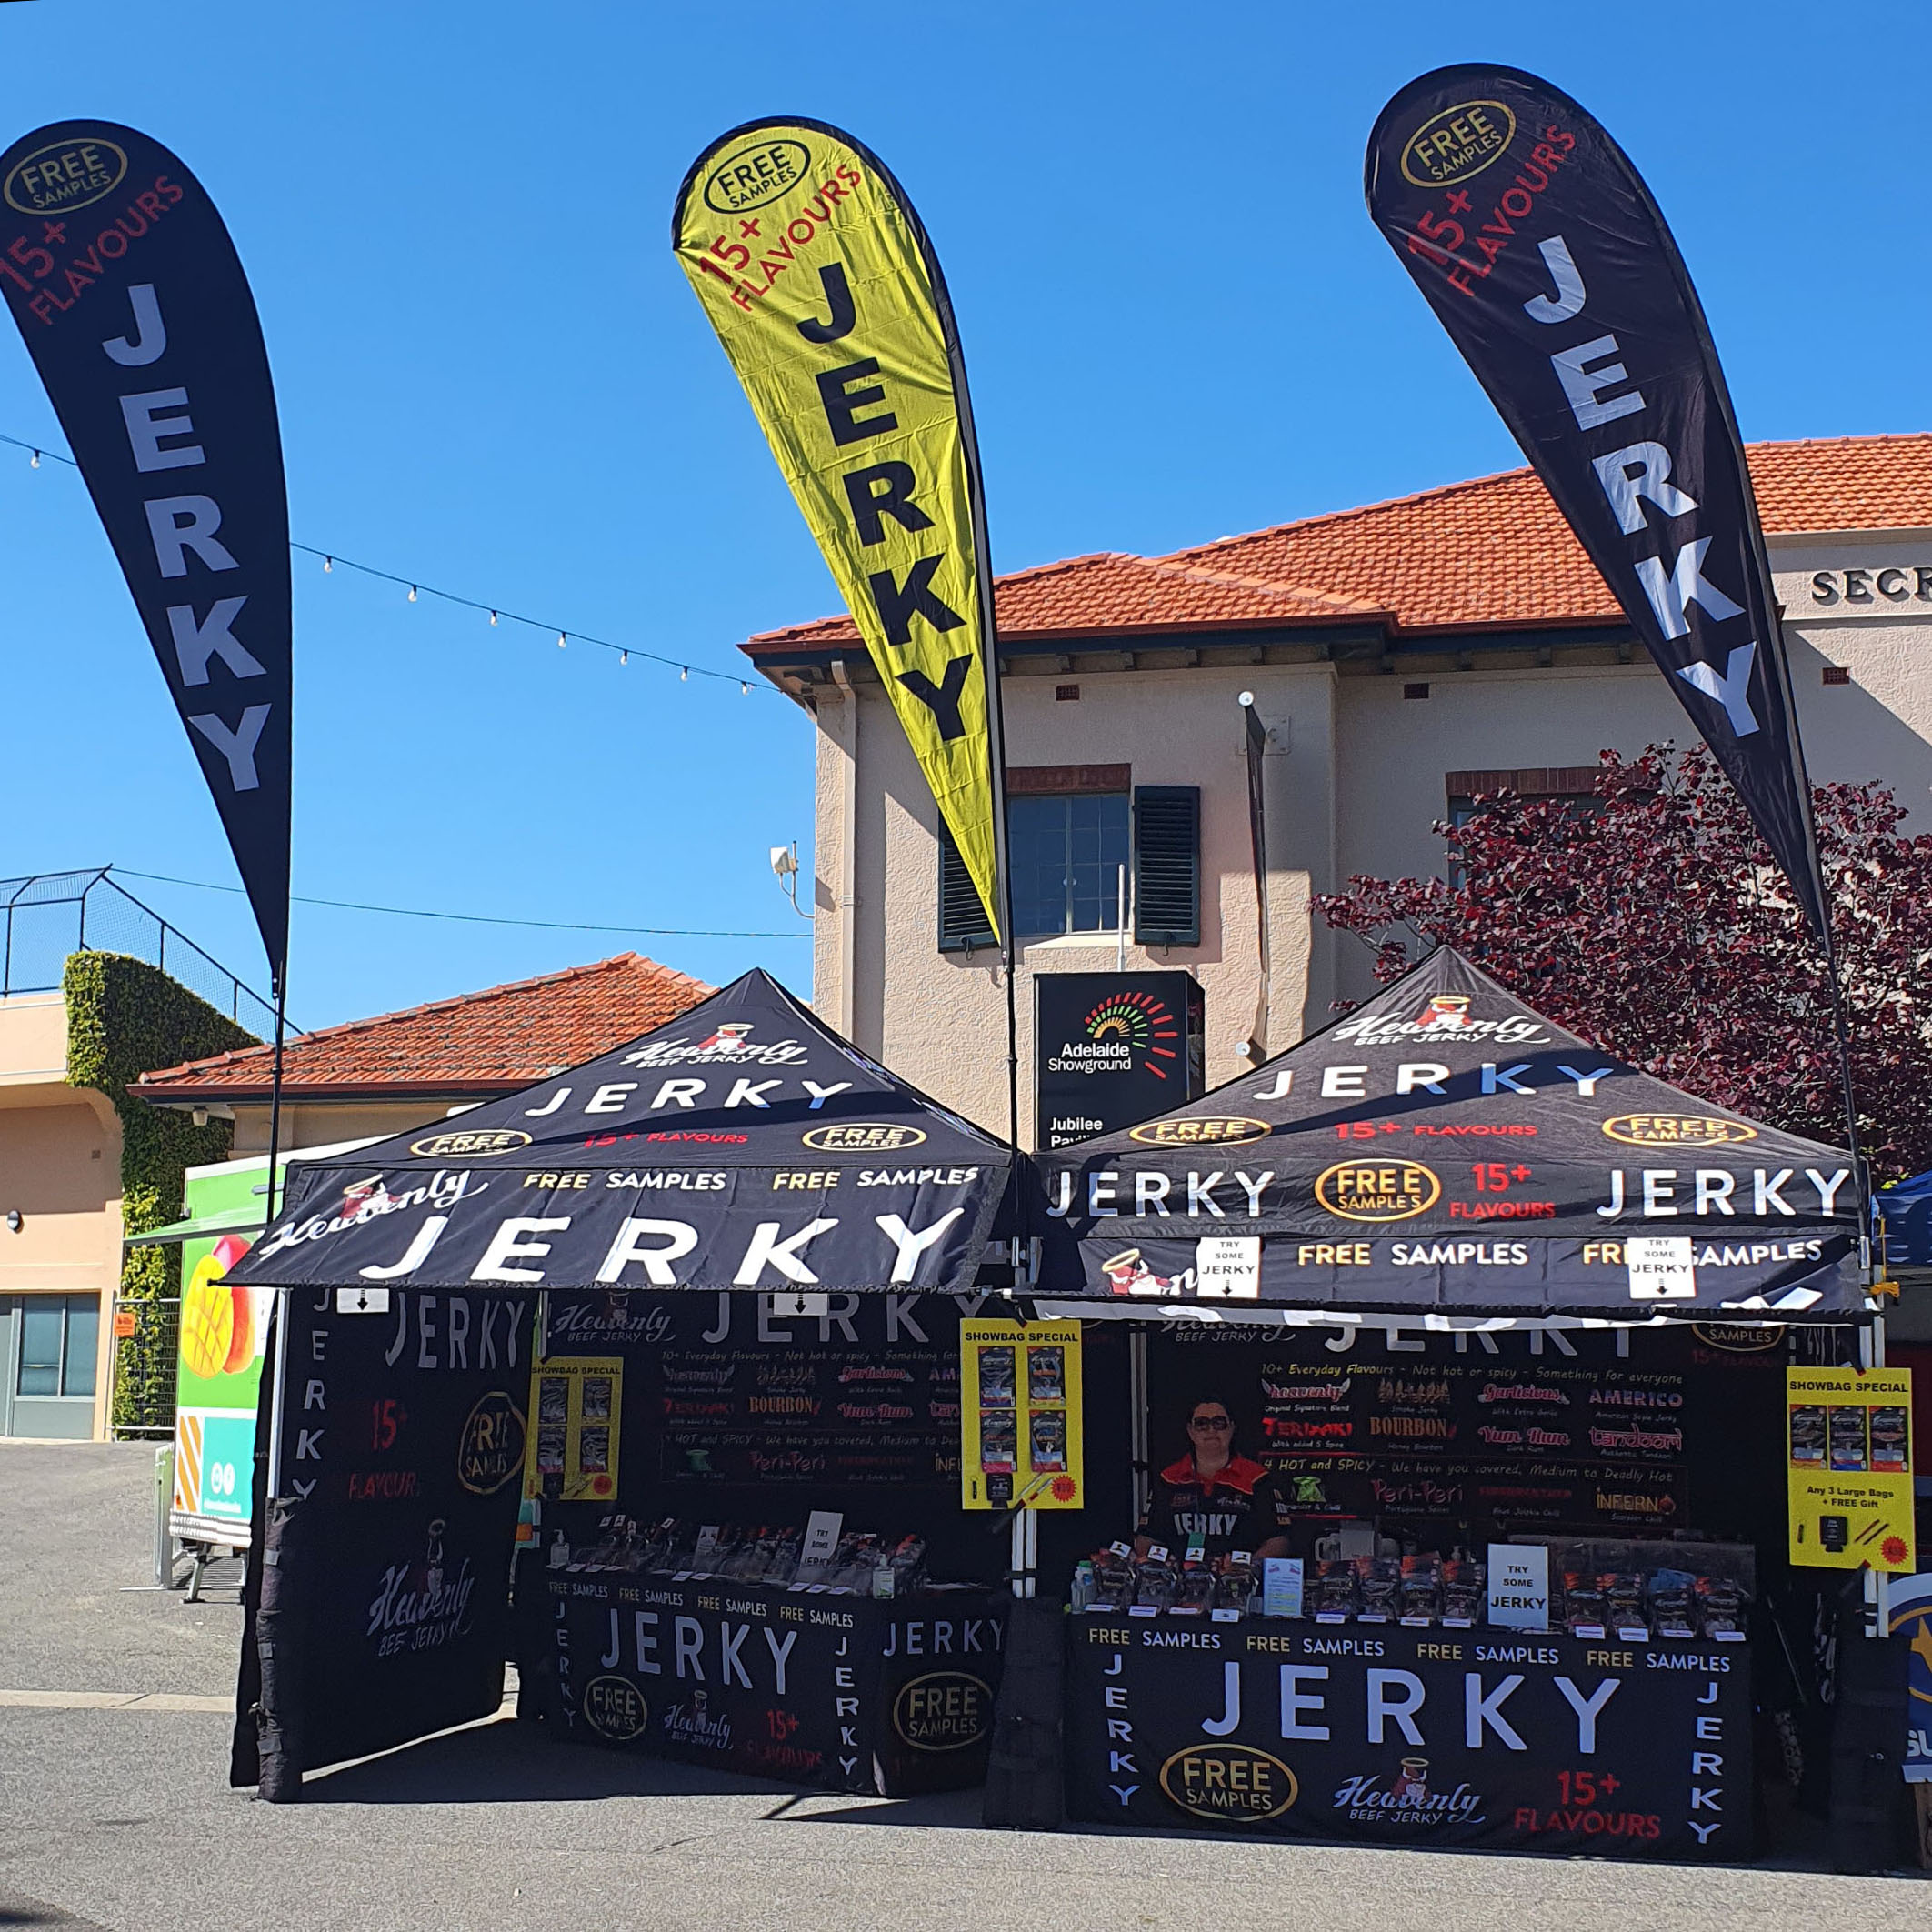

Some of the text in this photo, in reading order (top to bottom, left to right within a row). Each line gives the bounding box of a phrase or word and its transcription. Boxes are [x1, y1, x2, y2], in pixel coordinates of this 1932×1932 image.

[1414, 107, 1494, 167] FREE
[21, 145, 105, 194] FREE
[1430, 131, 1502, 181] SAMPLES
[717, 145, 791, 196] FREE
[33, 170, 111, 208] SAMPLES
[729, 166, 796, 208] SAMPLES
[1447, 125, 1576, 297] FLAVOURS
[730, 164, 861, 312] FLAVOURS
[1408, 189, 1473, 265] 15+
[0, 221, 65, 292] 15+
[29, 175, 183, 325] FLAVOURS
[699, 217, 761, 284] 15+
[1522, 235, 1760, 737] JERKY
[796, 261, 972, 742] JERKY
[102, 283, 272, 792] JERKY
[1331, 1012, 1551, 1044] Heavenly
[1353, 1032, 1490, 1046] BEEF JERKY
[620, 1038, 808, 1066] Heavenly
[637, 1055, 750, 1068] BEEF JERKY
[1061, 1043, 1129, 1057] Adelaide
[1048, 1057, 1131, 1074] Showground
[1253, 1063, 1615, 1100] JERKY
[525, 1078, 853, 1116] JERKY
[825, 1127, 907, 1140] FREE
[1050, 1117, 1103, 1131] Jubilee
[1155, 1121, 1246, 1135] FREE
[1334, 1121, 1538, 1139] 15+ FLAVOURS
[1629, 1117, 1728, 1133] FREE
[434, 1135, 512, 1146] FREE
[584, 1132, 749, 1149] 15+ FLAVOURS
[822, 1138, 902, 1148] SAMPLES
[523, 1167, 978, 1191] FREE SAMPLES FREE SAMPLES
[1336, 1169, 1422, 1195] FREE
[1472, 1163, 1532, 1193] 15+
[1046, 1170, 1275, 1218] JERKY
[1337, 1195, 1422, 1209] SAMPLES
[1596, 1168, 1850, 1218] JERKY
[258, 1169, 489, 1261] Heavenly
[1449, 1201, 1556, 1219] FLAVOURS
[358, 1207, 965, 1285] JERKY
[1298, 1239, 1823, 1266] FREE SAMPLES FR SAMPLES
[1644, 1250, 1676, 1258] SOME
[1648, 1239, 1670, 1247] TRY
[1202, 1265, 1256, 1275] JERKY
[1631, 1262, 1690, 1274] JERKY
[385, 1292, 526, 1370] JERKY
[555, 1303, 676, 1343] Heavenly
[567, 1331, 641, 1342] BEEF JERKY
[1175, 1331, 1257, 1342] BEEF JERKY
[1709, 1328, 1772, 1343] SAMPLES
[965, 1332, 1078, 1342] SHOWBAG SPECIAL
[1261, 1363, 1682, 1386] 10+ Everyday Flavours Not hot or spicy Something for everyone
[1789, 1380, 1908, 1393] SHOWBAG SPECIAL
[749, 1396, 813, 1414] BOURBON
[1589, 1388, 1683, 1408] AMERICO
[1369, 1416, 1447, 1437] BOURBON
[1279, 1458, 1306, 1471] HOT
[1310, 1458, 1331, 1470] and
[1338, 1458, 1375, 1471] SPICY
[1391, 1461, 1409, 1473] We
[1416, 1461, 1441, 1473] have
[1447, 1464, 1469, 1476] you
[1530, 1464, 1577, 1477] Medium
[1604, 1467, 1644, 1482] Deadly
[1649, 1469, 1674, 1483] Hot
[1370, 1477, 1464, 1504] Peri-Peri
[1807, 1486, 1894, 1498] Any 3 Large Bags
[1831, 1498, 1857, 1507] FREE
[1860, 1499, 1879, 1508] Gift
[1502, 1578, 1534, 1587] SOME
[1507, 1566, 1529, 1574] TRY
[572, 1583, 608, 1599] SAMPLES
[619, 1587, 640, 1602] FREE
[645, 1589, 684, 1607] SAMPLES
[697, 1595, 721, 1611] FREE
[726, 1598, 767, 1617] SAMPLES
[780, 1606, 804, 1622] FREE
[809, 1608, 854, 1628] SAMPLES
[1490, 1596, 1546, 1611] JERKY
[600, 1608, 798, 1695] JERKY
[882, 1619, 1004, 1657] JERKY
[1088, 1628, 1731, 1673] FREE SAMPLES FREE SAMPLES FREE SAMPLES FREE SAMPLES
[592, 1687, 636, 1716] FREE
[835, 1636, 860, 1776] JERKY
[909, 1686, 978, 1718] FREE
[1201, 1660, 1621, 1754] JERKY
[909, 1717, 977, 1737] SAMPLES
[1102, 1653, 1141, 1807] JERKY
[1183, 1757, 1272, 1792] FREE
[1687, 1681, 1724, 1845] JERKY
[1185, 1787, 1273, 1811] SAMPLES
[1332, 1774, 1486, 1823] Heavenly
[1557, 1769, 1621, 1807] 15+
[1348, 1808, 1444, 1826] BEEF JERKY
[1514, 1807, 1661, 1839] FLAVOURS
